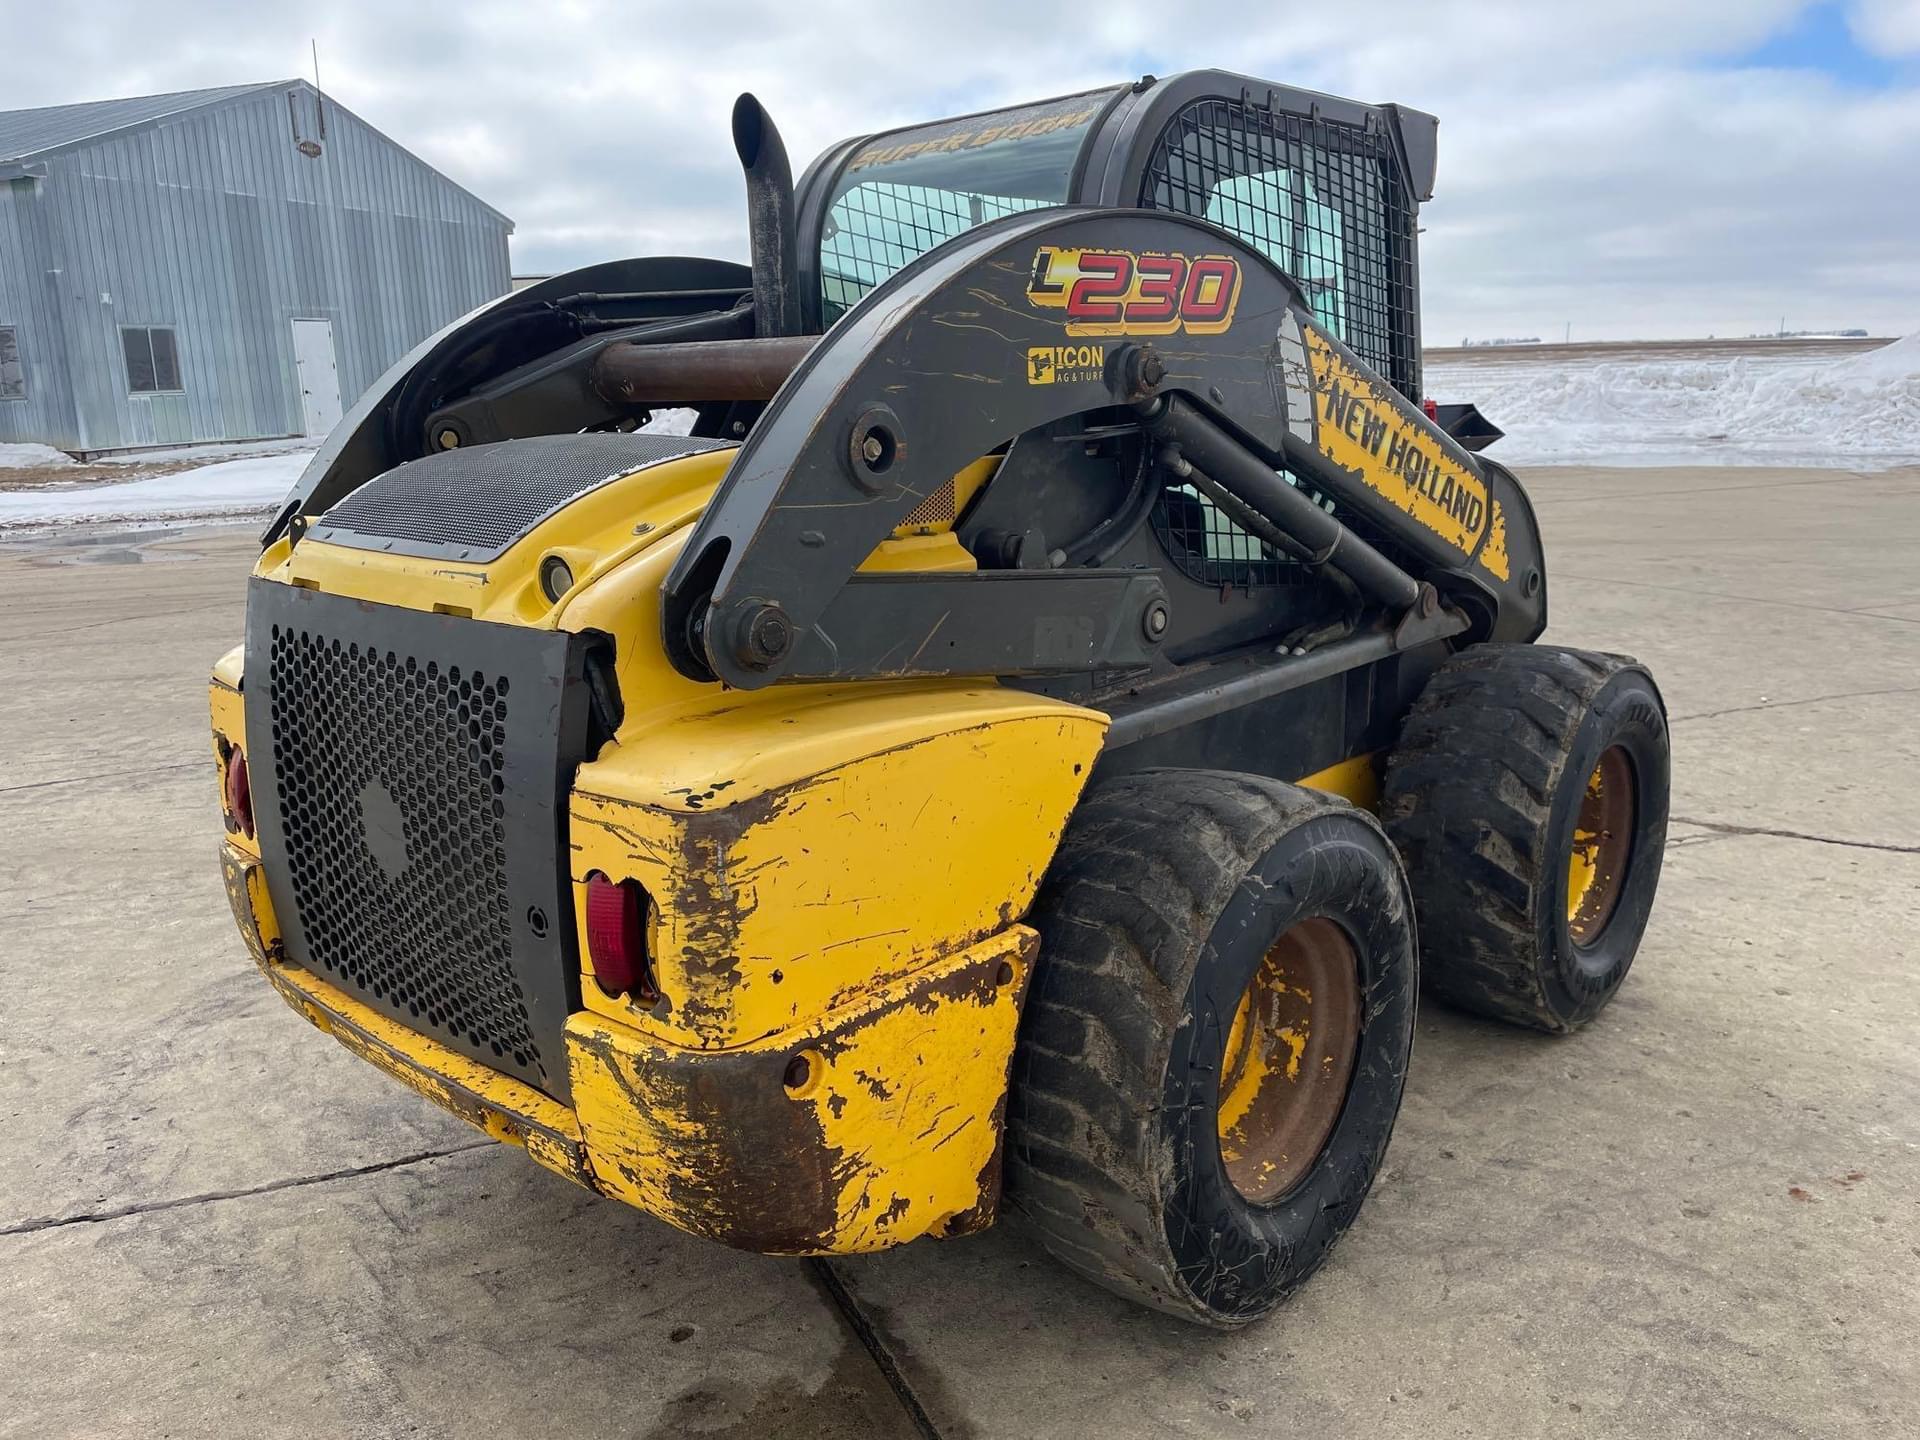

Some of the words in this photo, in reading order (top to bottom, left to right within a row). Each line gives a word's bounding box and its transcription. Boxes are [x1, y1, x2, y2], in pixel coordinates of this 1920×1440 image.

[1027, 246, 1243, 336] L230
[1055, 345, 1104, 369] ICON
[1057, 372, 1070, 383] AG
[1071, 371, 1078, 382] &
[1079, 370, 1105, 382] TURF
[1324, 379, 1389, 458] NEW
[1385, 430, 1485, 534] HOLLAND
